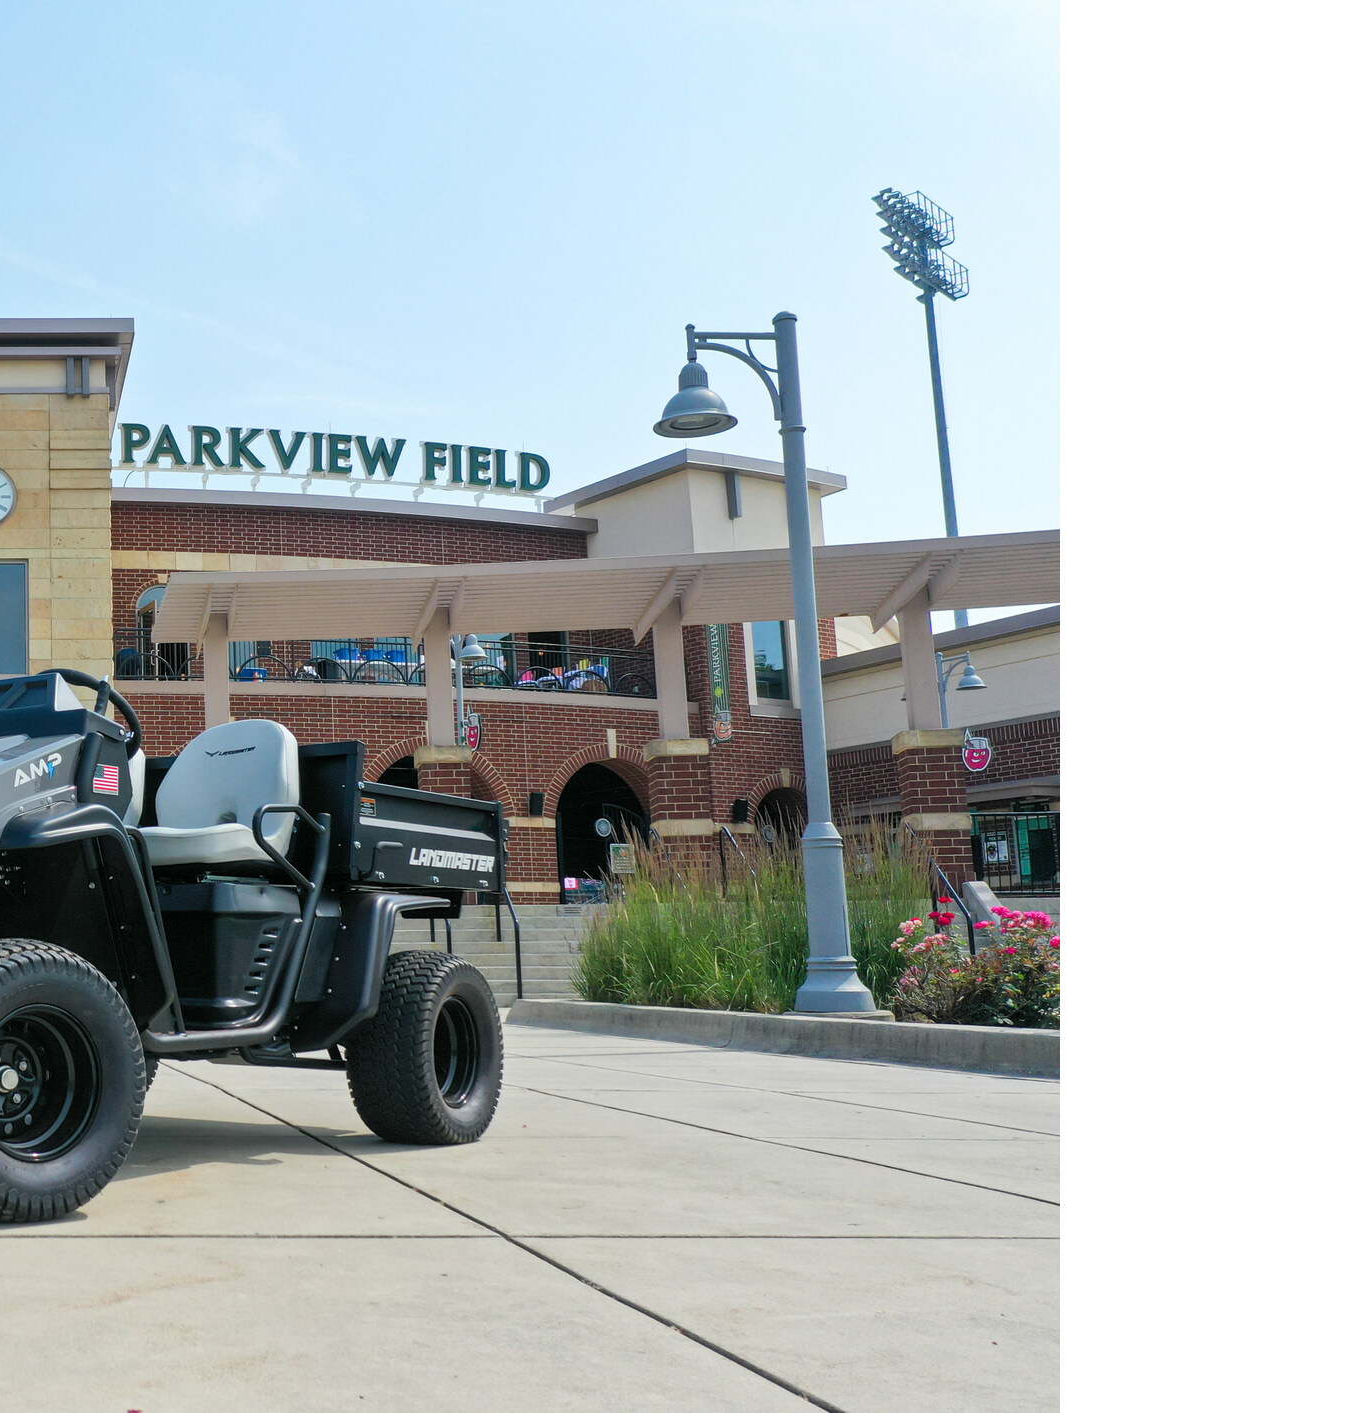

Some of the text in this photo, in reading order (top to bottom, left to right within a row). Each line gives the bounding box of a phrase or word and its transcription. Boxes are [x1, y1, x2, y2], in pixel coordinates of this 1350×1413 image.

[118, 422, 551, 494] PARKVIEW FIELD
[710, 625, 721, 682] PARKVIEW
[13, 752, 63, 788] AMP
[408, 847, 496, 873] LANDMASTER
